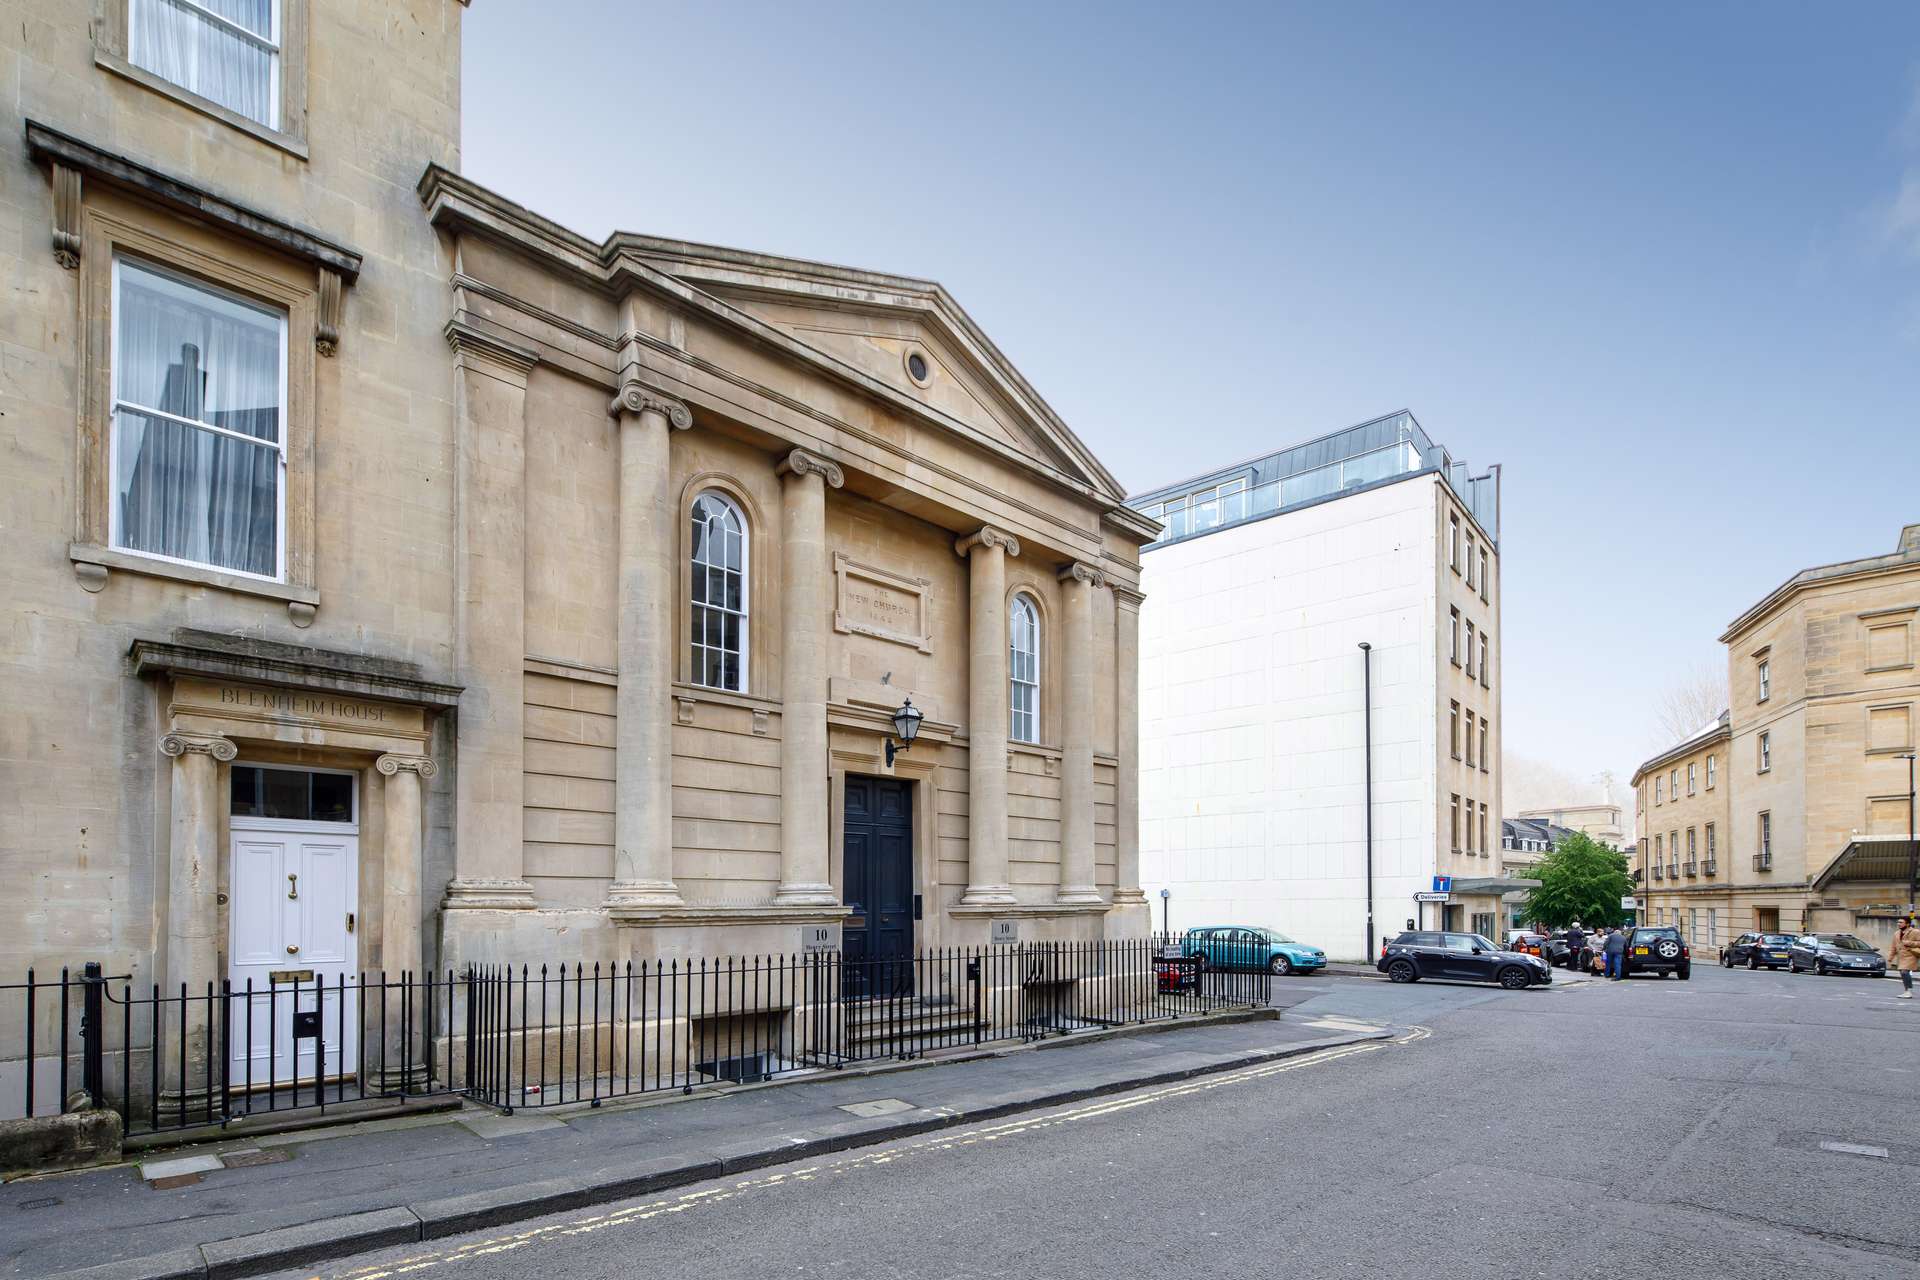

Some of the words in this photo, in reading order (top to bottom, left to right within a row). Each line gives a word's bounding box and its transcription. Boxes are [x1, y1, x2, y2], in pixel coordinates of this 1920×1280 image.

[221, 687, 325, 714] BLENHEIM
[331, 703, 388, 721] HOUSE
[1001, 923, 1010, 934] 10
[816, 929, 828, 941] 10
